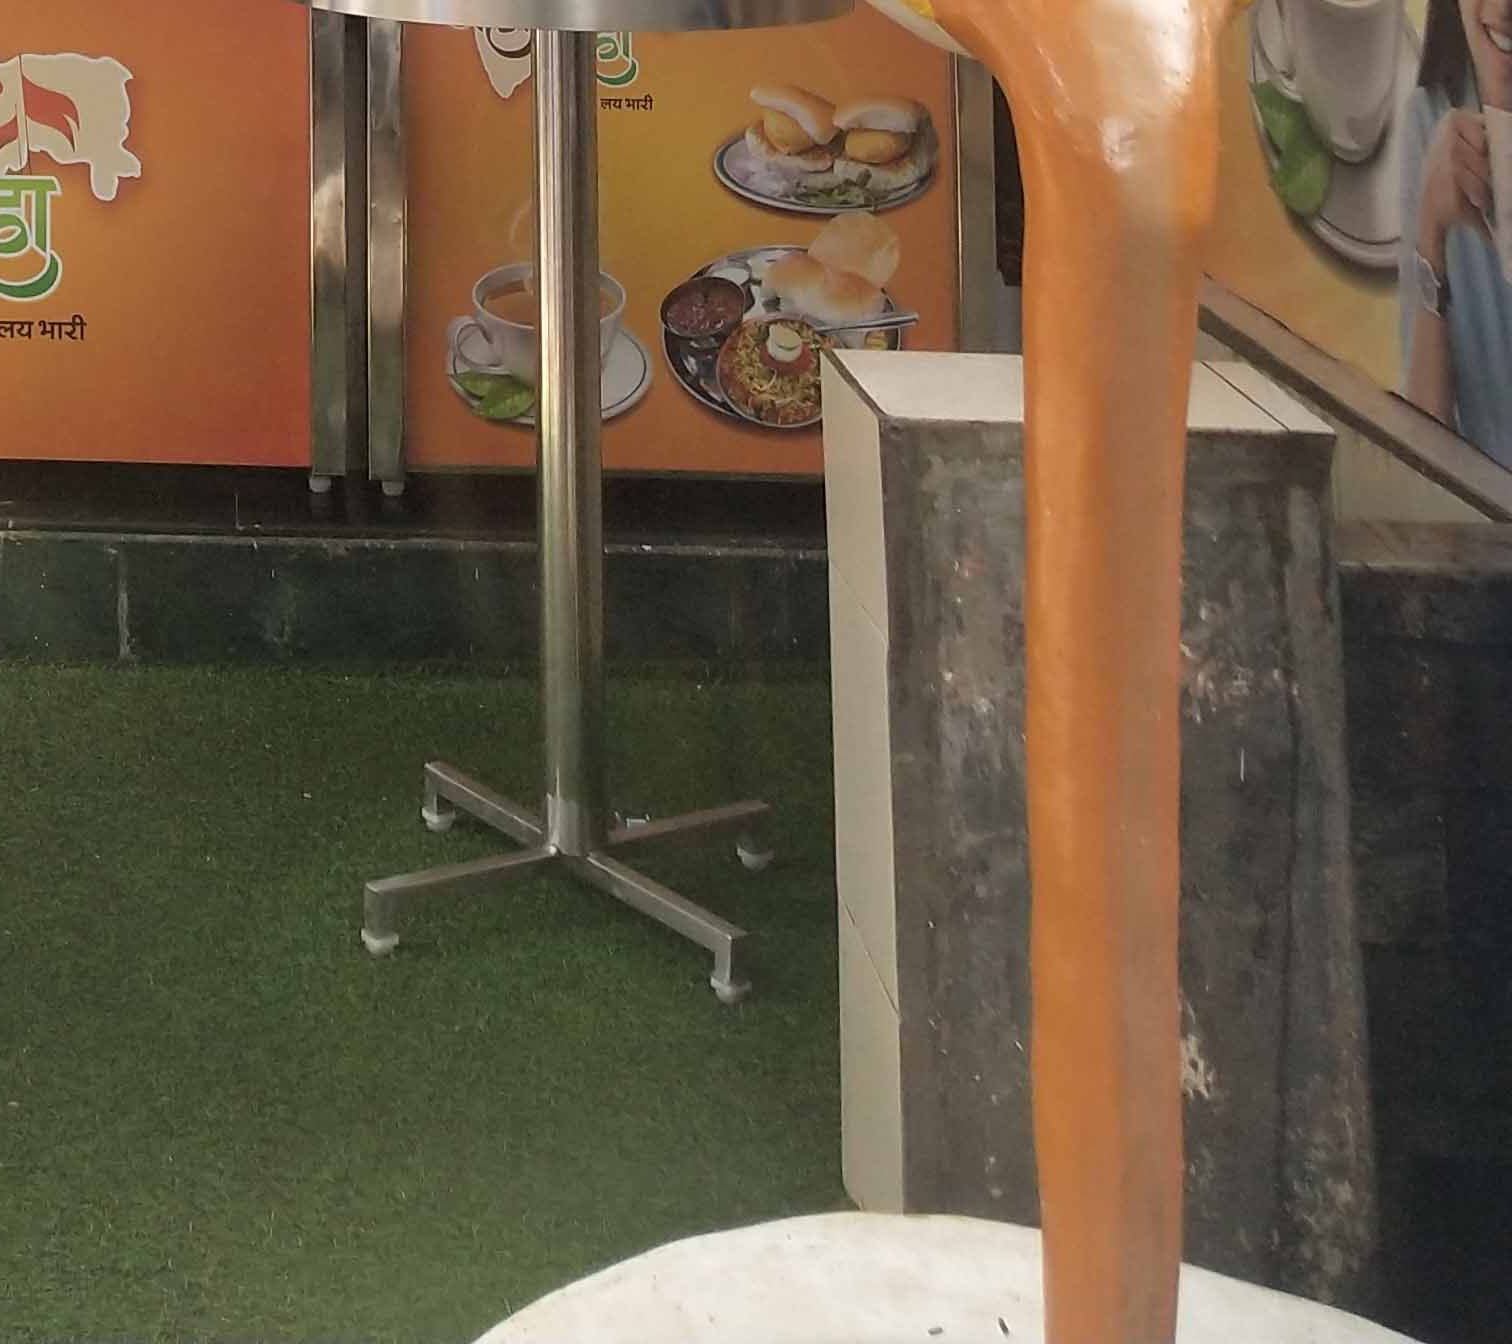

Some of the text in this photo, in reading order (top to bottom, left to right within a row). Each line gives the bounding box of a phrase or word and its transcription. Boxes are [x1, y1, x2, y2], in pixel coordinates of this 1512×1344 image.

[600, 94, 654, 111] लय भारी
[38, 314, 88, 341] भारी
